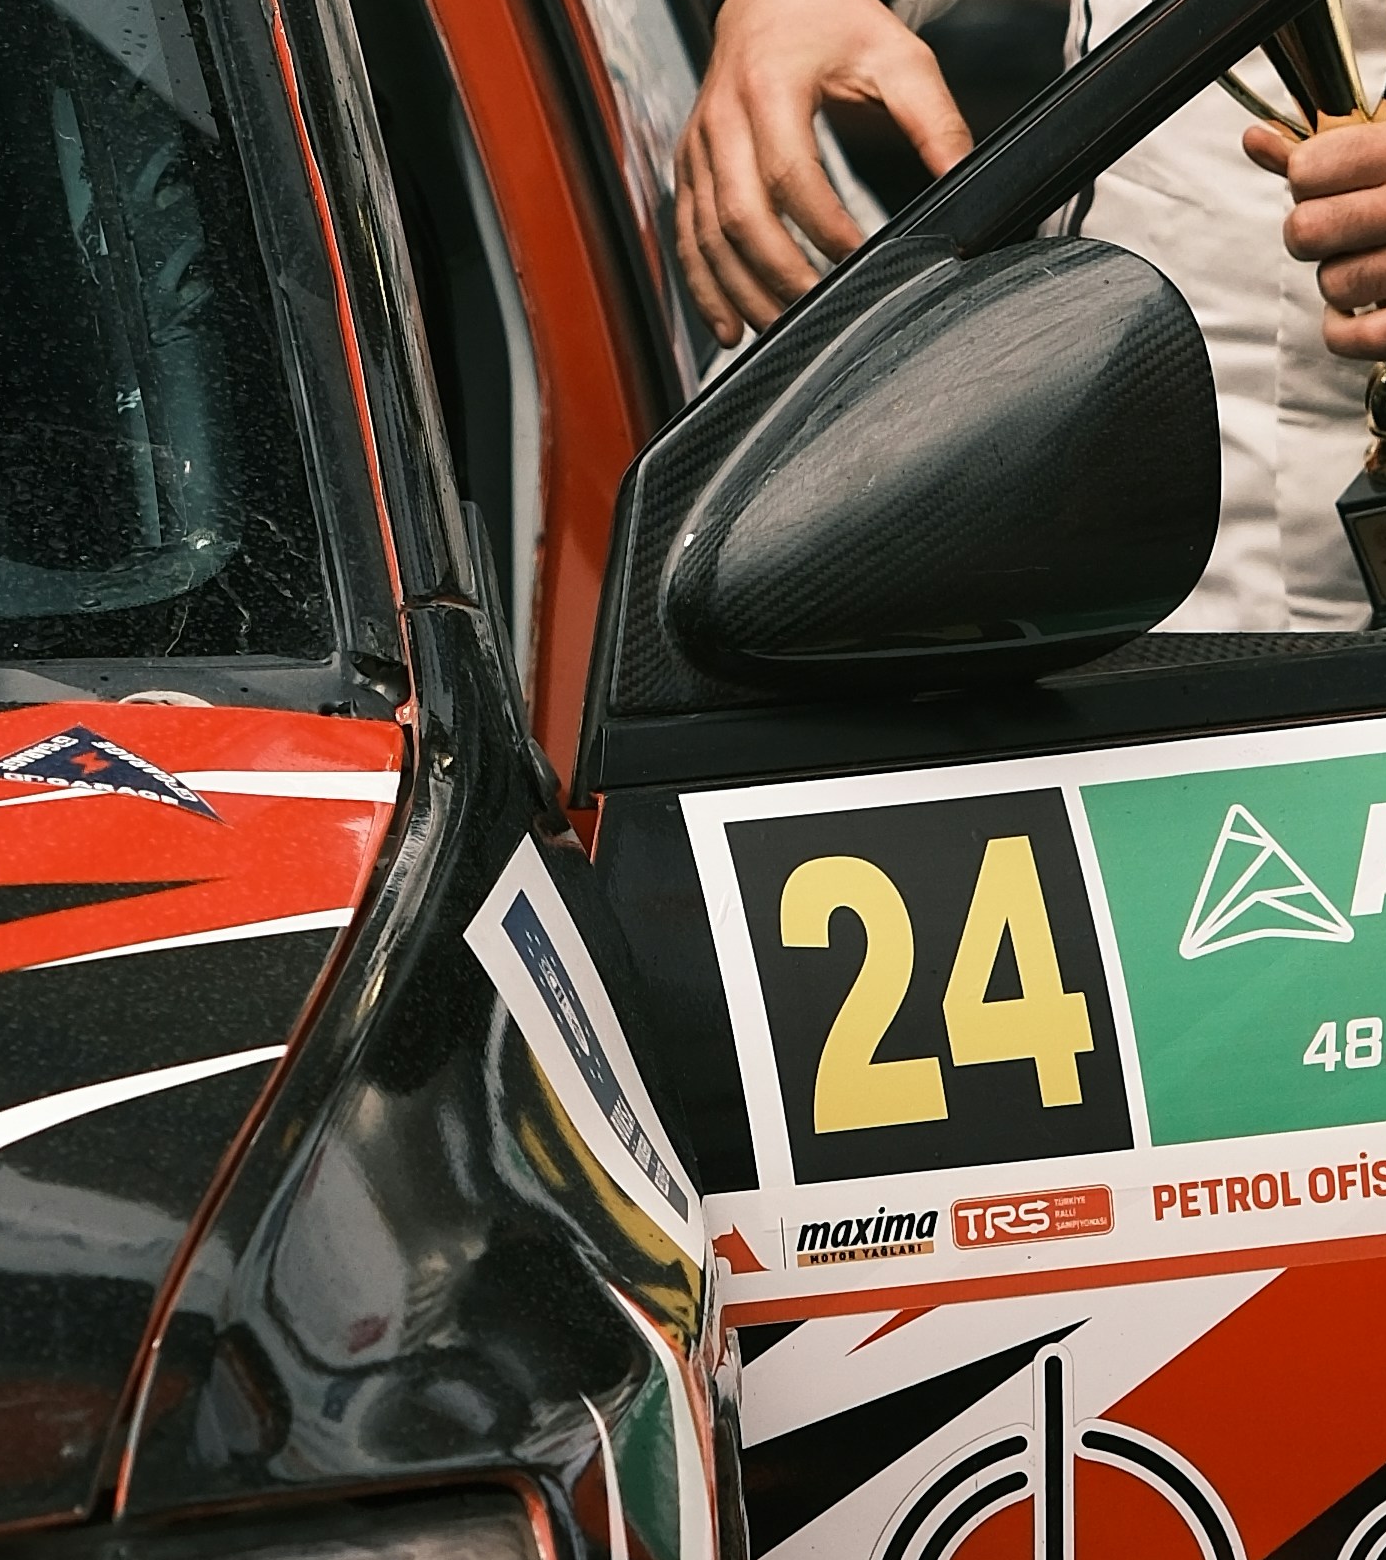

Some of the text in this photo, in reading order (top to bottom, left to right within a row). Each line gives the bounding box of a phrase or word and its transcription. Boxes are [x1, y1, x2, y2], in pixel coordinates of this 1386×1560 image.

[779, 834, 1095, 1135] 24
[957, 1199, 1051, 1241] TRS
[1152, 1172, 1302, 1222] PETROL
[796, 1206, 939, 1252] maxima
[810, 1249, 856, 1264] MOTOR
